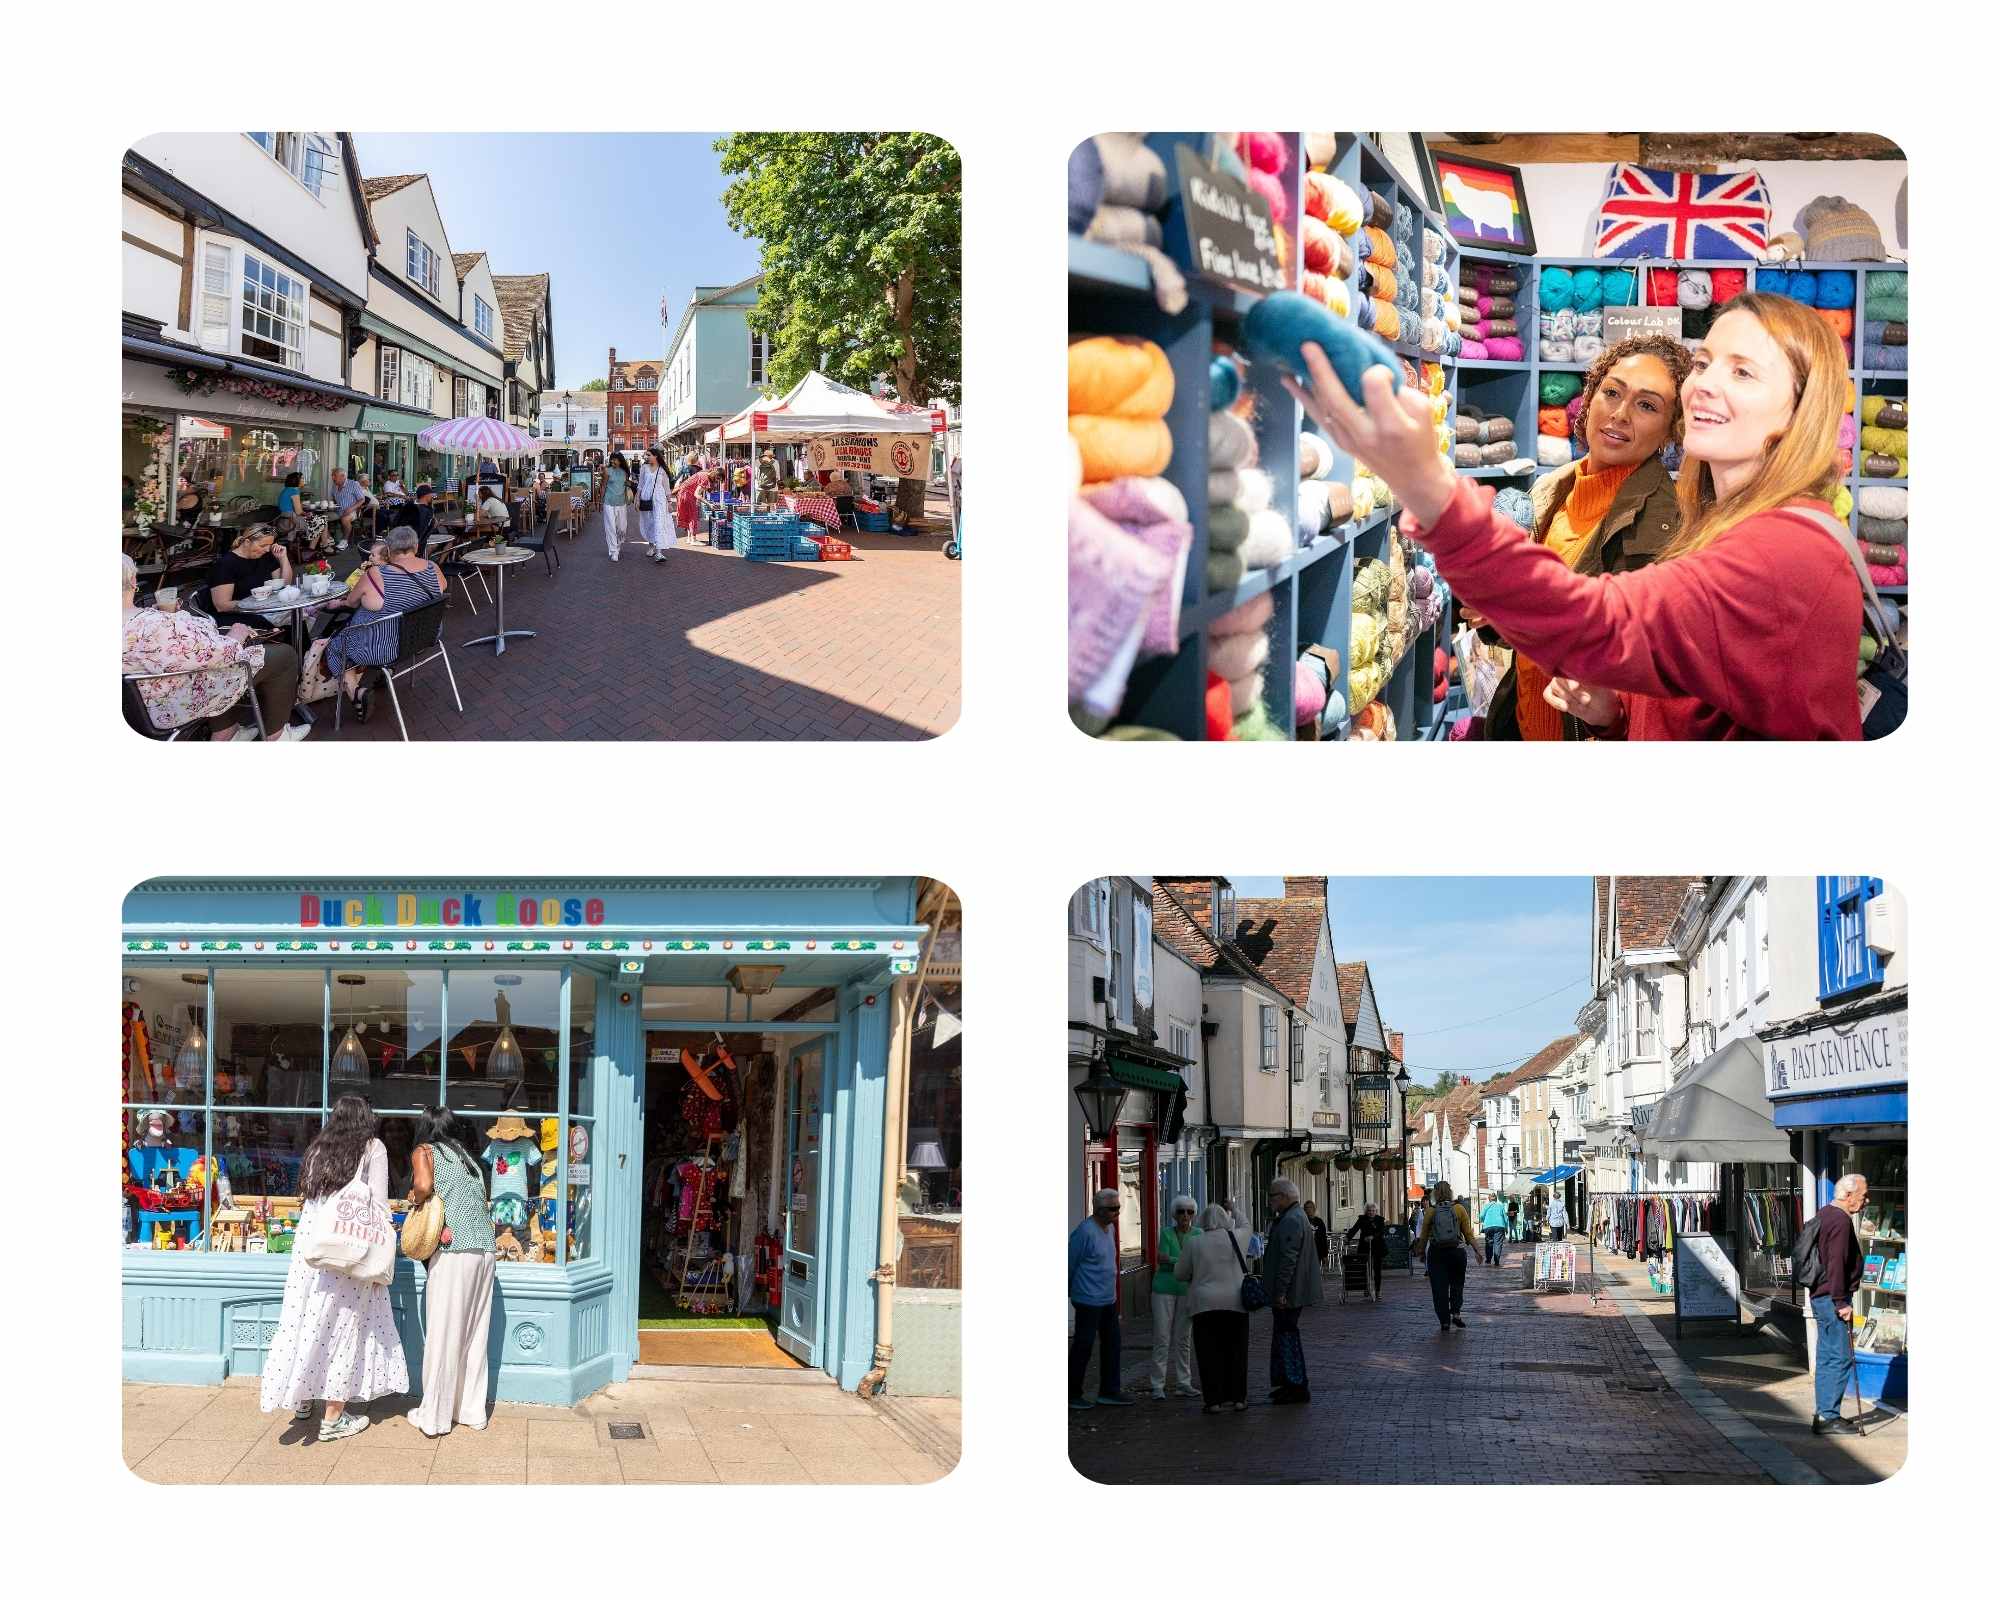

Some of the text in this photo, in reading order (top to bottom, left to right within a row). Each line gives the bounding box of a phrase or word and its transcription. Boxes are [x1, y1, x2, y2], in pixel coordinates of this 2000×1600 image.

[1608, 317, 1642, 325] Colour
[1644, 316, 1664, 326] Lab
[300, 891, 605, 928] Duck Duck Goose
[1792, 1044, 1817, 1081] PAST
[1820, 1027, 1892, 1077] SENTENCE
[1631, 1104, 1654, 1126] Riv
[618, 1153, 627, 1169] 7
